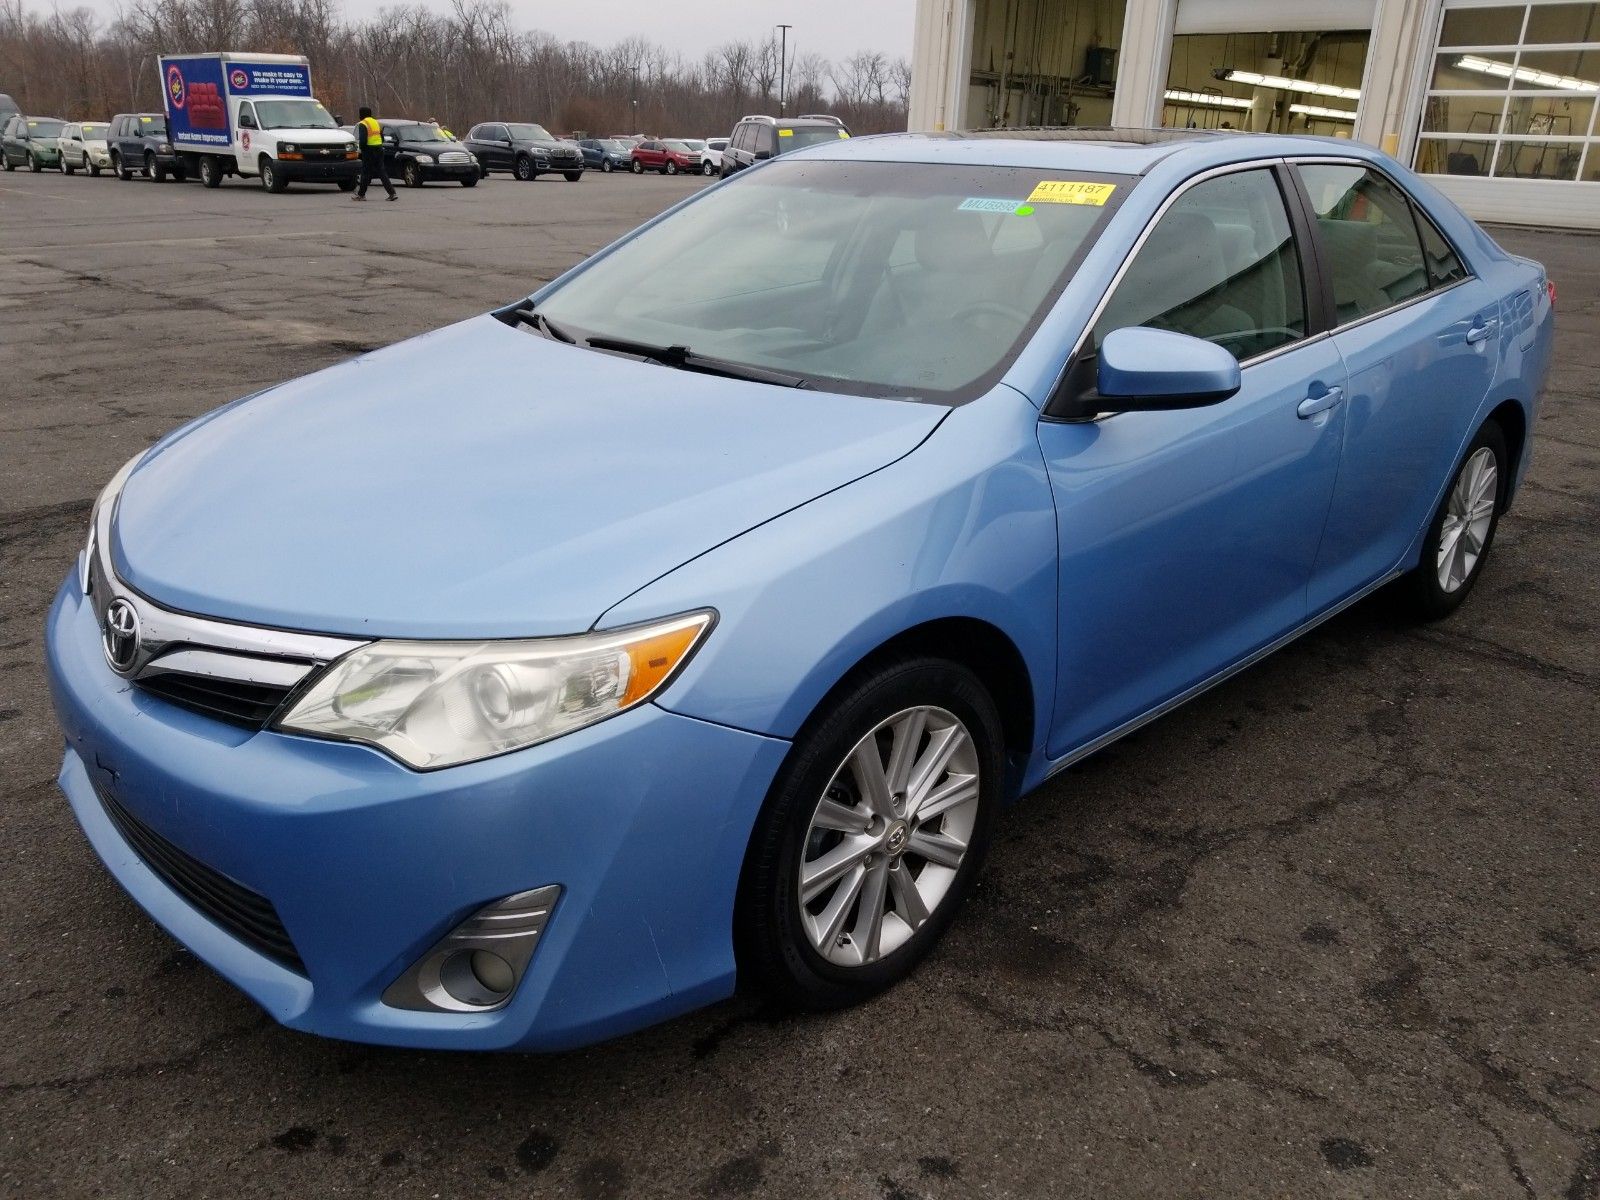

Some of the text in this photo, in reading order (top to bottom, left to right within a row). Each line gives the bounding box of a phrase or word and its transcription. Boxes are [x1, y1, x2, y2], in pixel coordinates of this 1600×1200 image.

[178, 132, 191, 140] Instant
[202, 133, 228, 142] Improvement
[1038, 183, 1107, 194] 4111187
